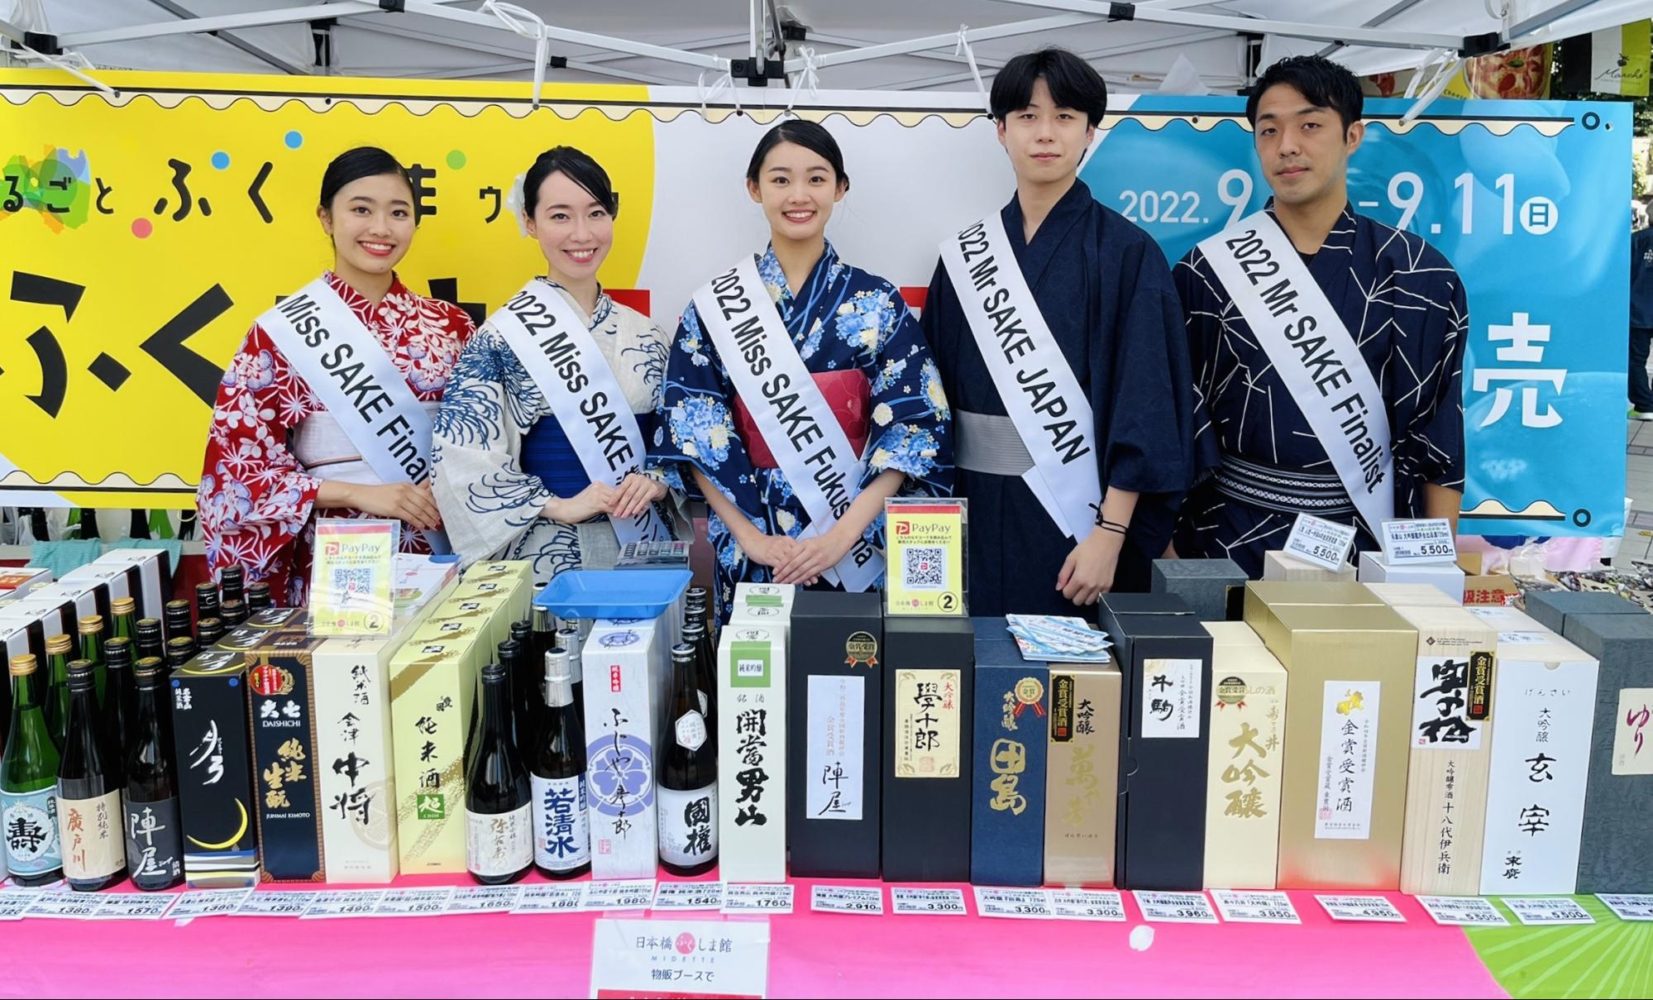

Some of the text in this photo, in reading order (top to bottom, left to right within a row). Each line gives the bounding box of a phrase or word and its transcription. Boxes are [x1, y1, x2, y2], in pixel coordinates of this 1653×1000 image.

[710, 267, 749, 321] 2022
[969, 255, 998, 292] Mr
[277, 293, 330, 349] Miss
[320, 343, 394, 424] SAKE
[729, 307, 771, 380] Miss
[983, 288, 1036, 364] SAKE
[1225, 229, 1386, 494] 2022 Mr SAKE Finalist
[537, 317, 588, 394] Miss
[579, 392, 634, 472] SAKE
[1472, 312, 1567, 428] 売
[761, 372, 824, 453] SAKE
[1015, 368, 1090, 466] JAPAN
[912, 523, 951, 535] PayPay
[260, 699, 301, 719] 大七
[262, 720, 300, 728] DAISHICHI
[1076, 698, 1095, 735] 大吟醸
[1536, 707, 1551, 742] 大吟醸
[1626, 703, 1650, 758] ゆり
[1221, 721, 1270, 818] 大吟醸
[1336, 719, 1359, 812] 金賞受賞酒
[130, 806, 166, 879] 陣屋
[543, 787, 580, 859] 若清水
[651, 968, 714, 982] 物販ブースで
